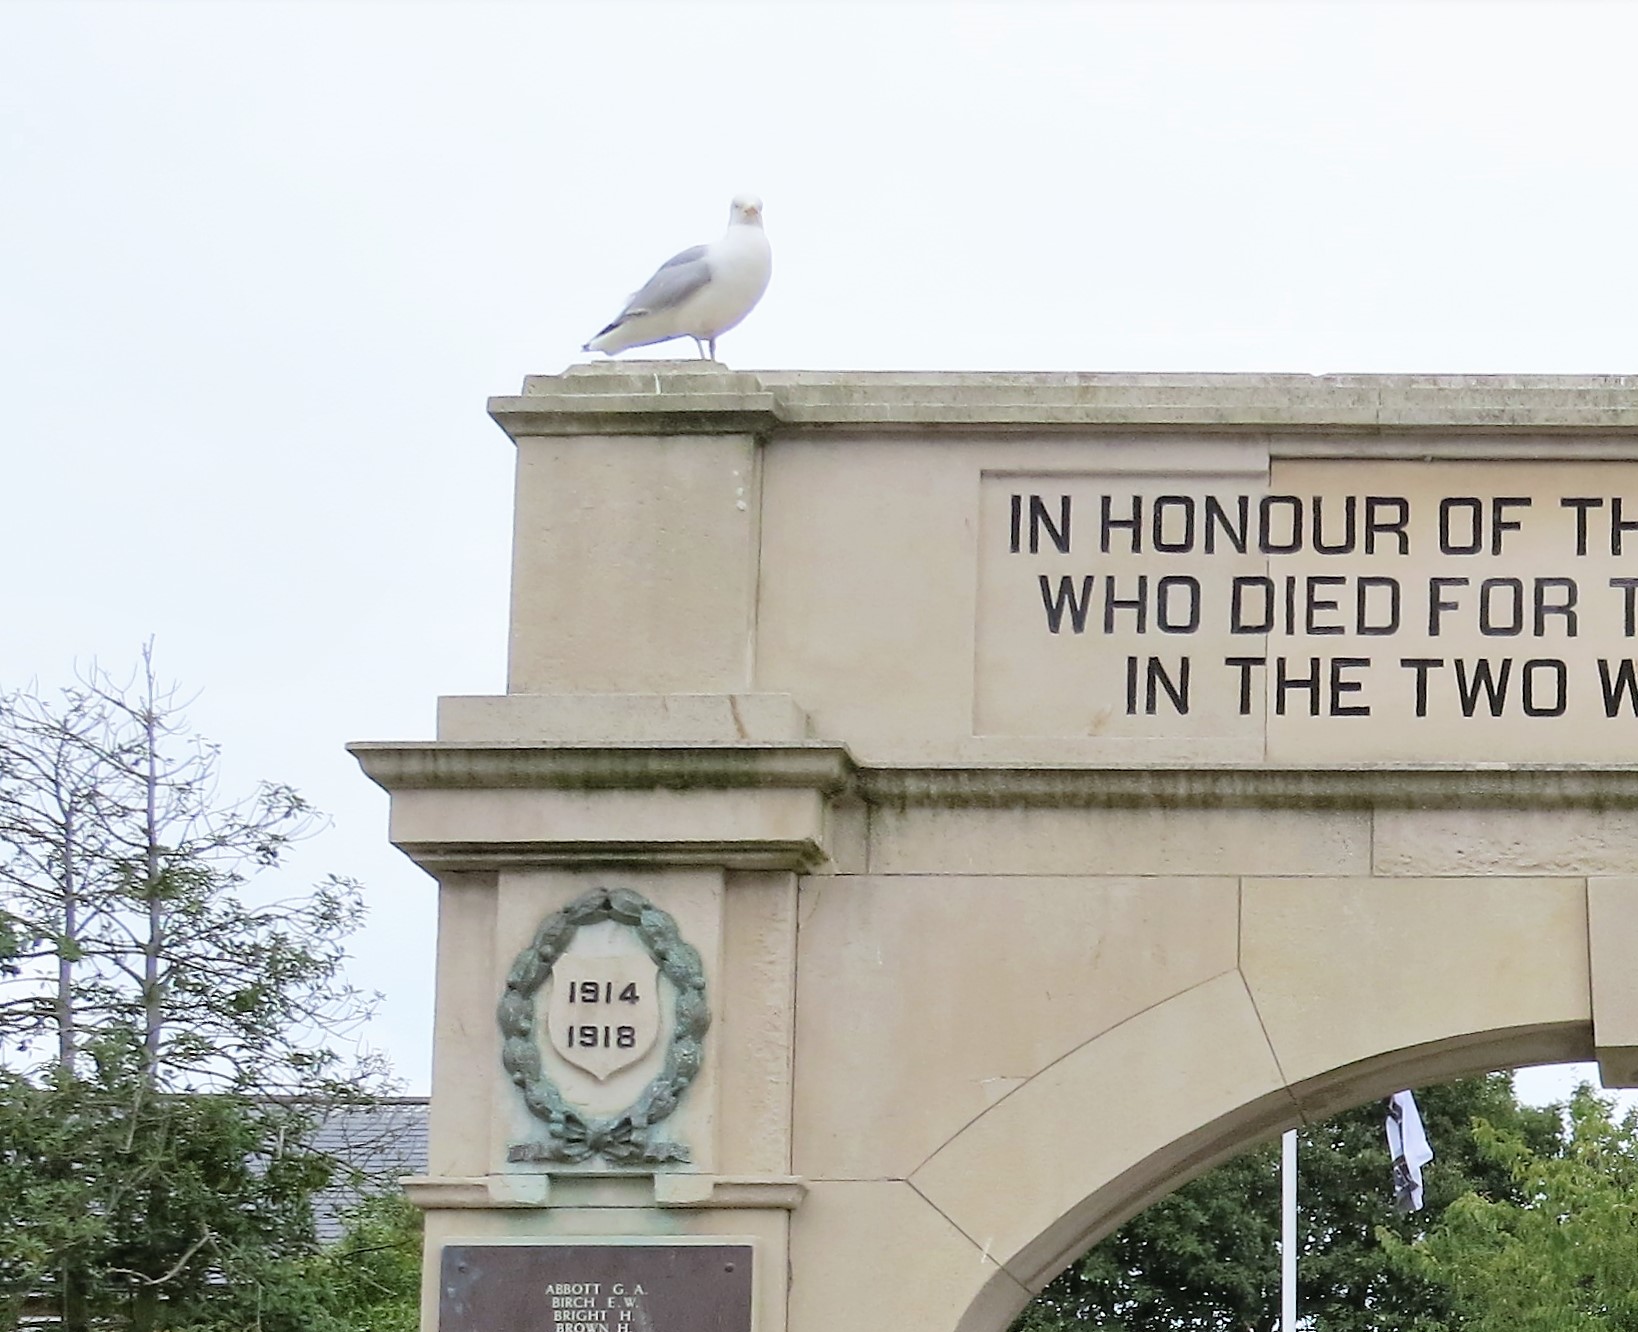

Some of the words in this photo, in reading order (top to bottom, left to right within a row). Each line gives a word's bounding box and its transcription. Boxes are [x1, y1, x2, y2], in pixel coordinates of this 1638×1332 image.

[1010, 495, 1071, 554] IN
[1100, 495, 1409, 556] HONOUR
[1438, 497, 1531, 556] OF
[1038, 574, 1200, 634] WHO
[1231, 575, 1400, 636] DIED
[1428, 576, 1578, 637] FOR
[1126, 656, 1190, 716] IN
[1224, 657, 1370, 717] THE
[1400, 658, 1567, 718] TWO
[568, 981, 640, 1005] 1914
[567, 1025, 636, 1048] 1918
[545, 1284, 601, 1294] ABBOTT
[552, 1297, 594, 1308] BIRCH
[554, 1310, 606, 1321] BRIGHT
[556, 1323, 608, 1332] BROWN
